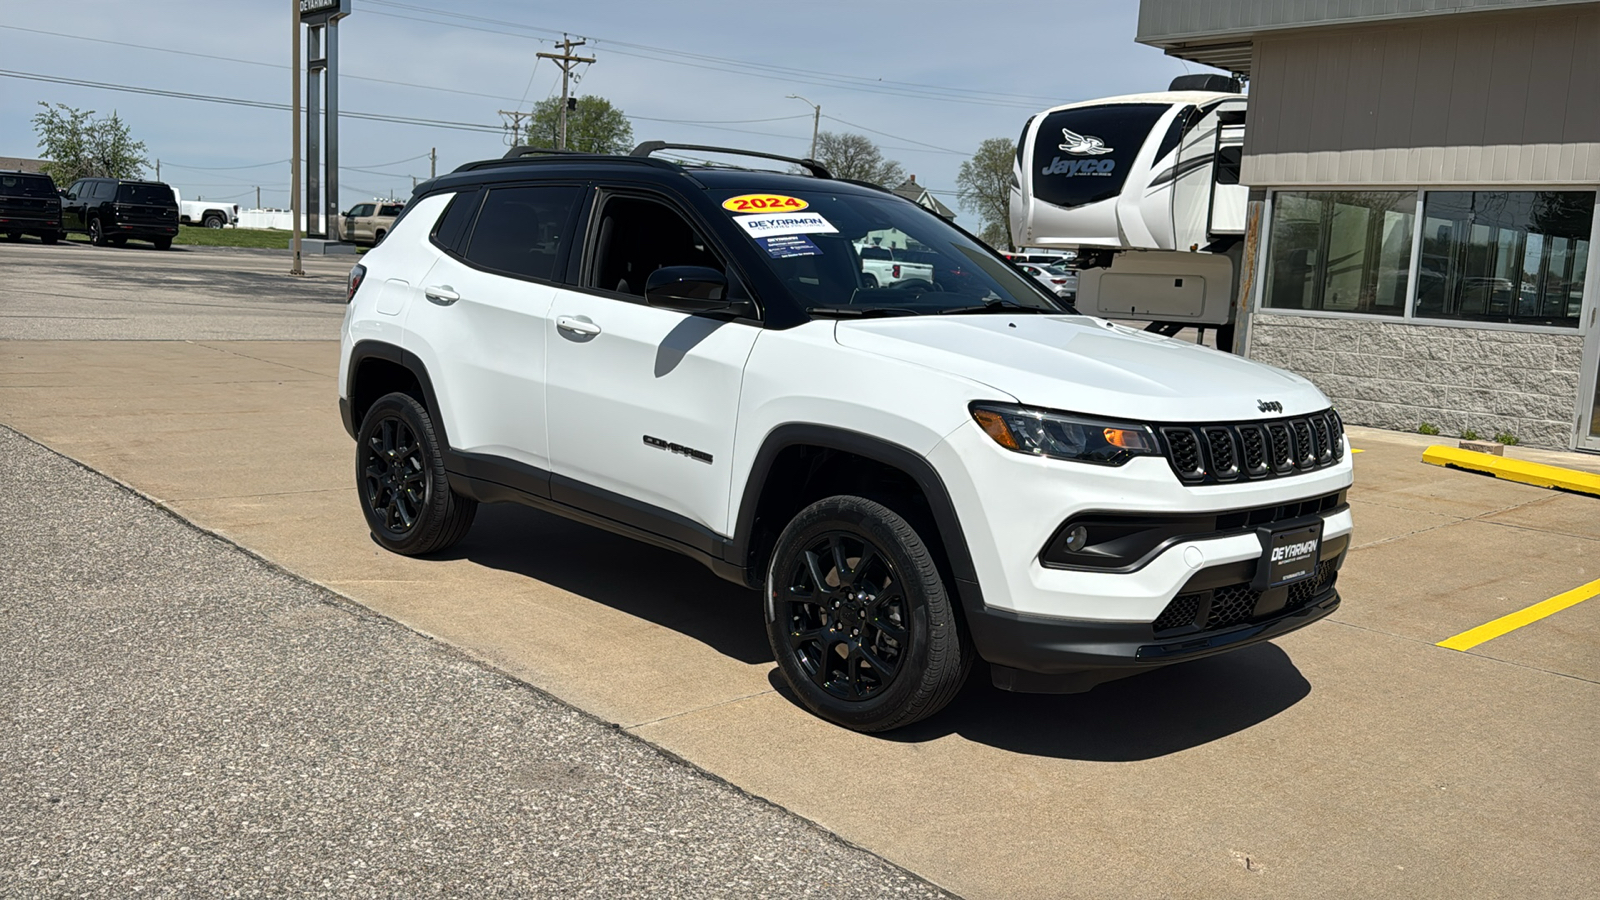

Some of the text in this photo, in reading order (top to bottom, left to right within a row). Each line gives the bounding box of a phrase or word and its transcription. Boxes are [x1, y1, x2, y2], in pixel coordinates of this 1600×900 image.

[1042, 157, 1115, 177] Jayco
[733, 198, 801, 210] 2024
[748, 218, 823, 228] DEYARMAN
[1257, 399, 1283, 414] Jeep
[643, 435, 713, 465] COMPASS
[1271, 539, 1318, 561] DEYARMAN
